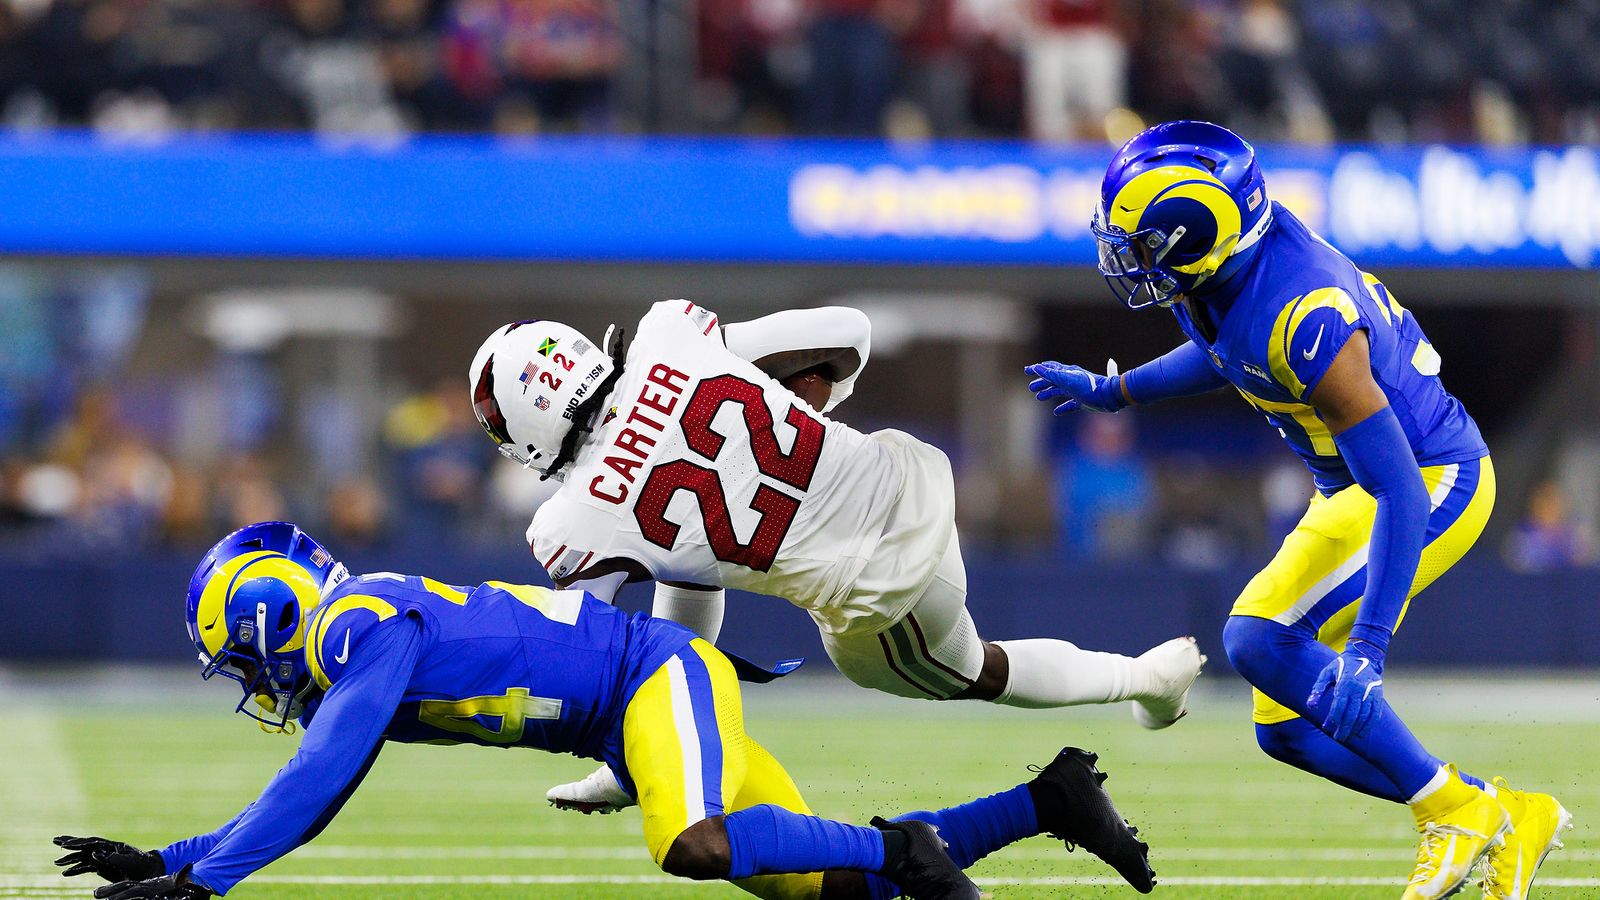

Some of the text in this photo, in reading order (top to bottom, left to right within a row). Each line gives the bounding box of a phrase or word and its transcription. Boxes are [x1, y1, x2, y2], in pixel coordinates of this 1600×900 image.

[562, 397, 580, 420] END
[575, 363, 605, 398] RACISM
[589, 363, 690, 505] CARTER
[633, 373, 826, 574] 22
